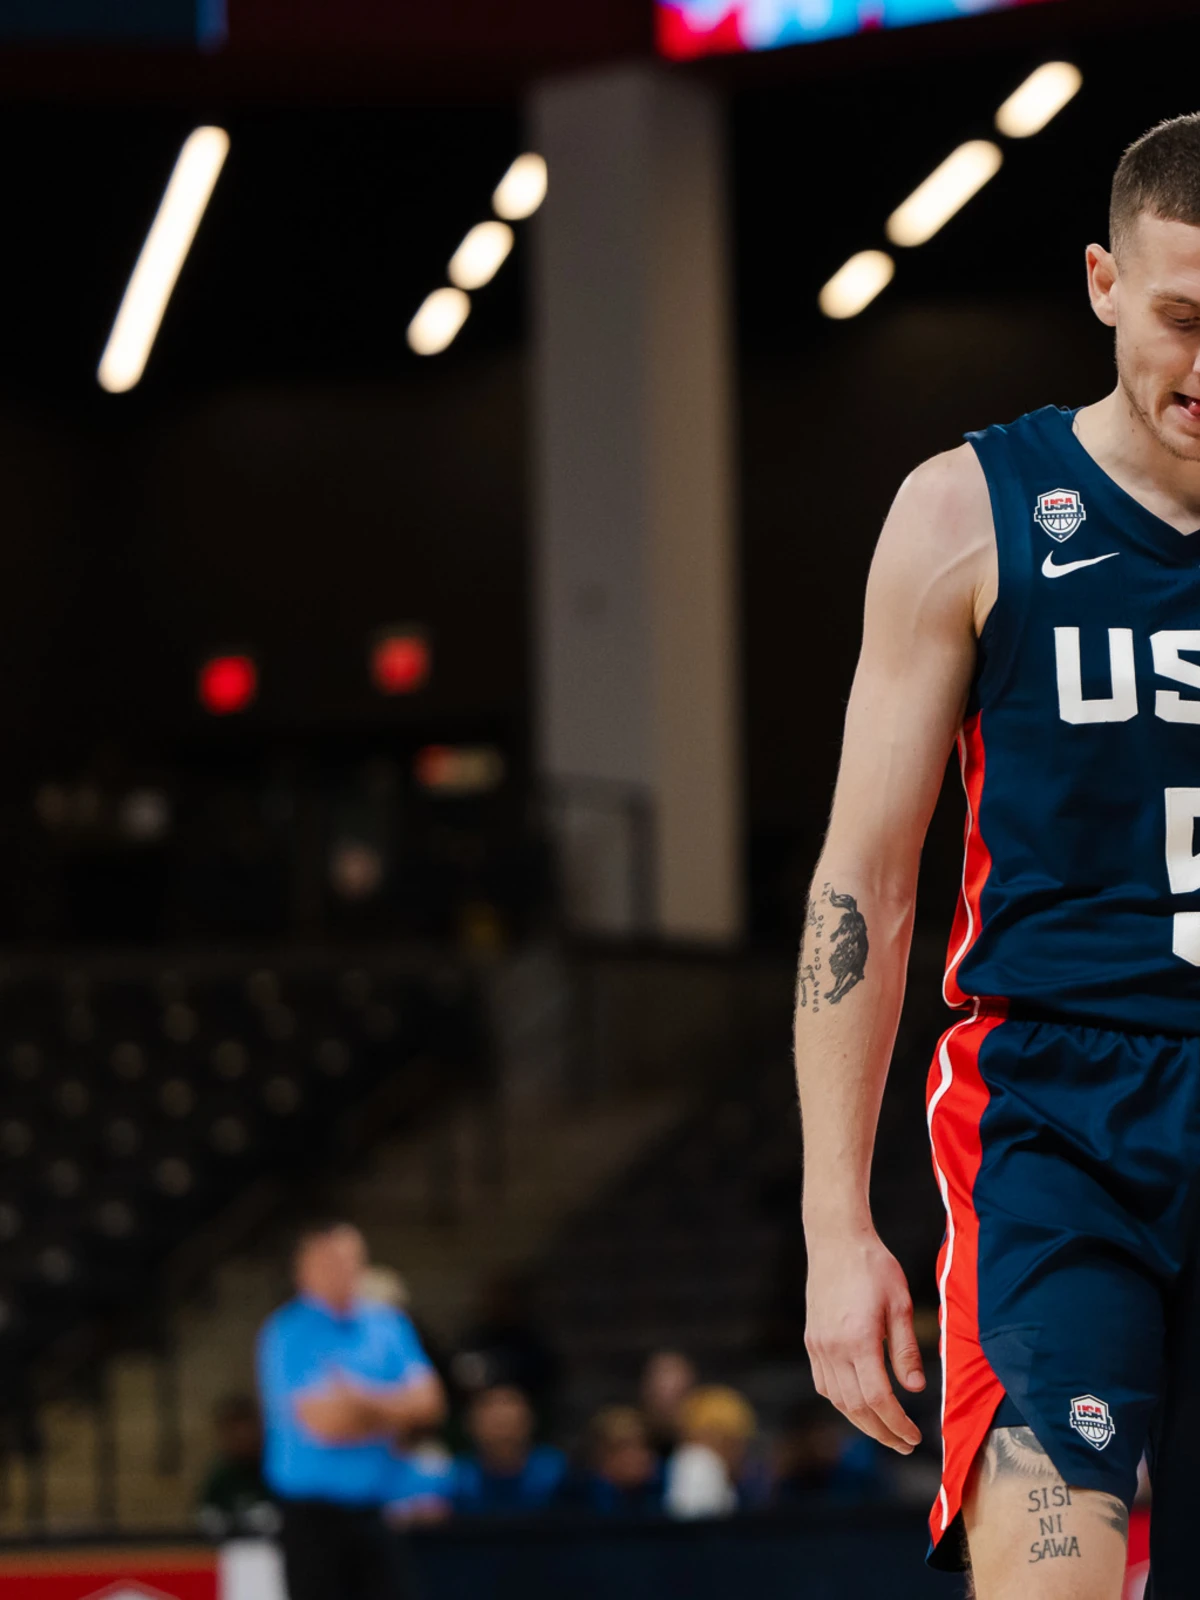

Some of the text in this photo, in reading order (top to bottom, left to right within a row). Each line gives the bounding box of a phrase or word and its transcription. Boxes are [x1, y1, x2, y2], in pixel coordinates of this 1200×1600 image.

[1044, 497, 1075, 511] USA
[1077, 1405, 1104, 1421] USA
[1028, 1485, 1072, 1513] SISI
[1039, 1514, 1063, 1536] NI
[1028, 1536, 1081, 1563] SAWA
